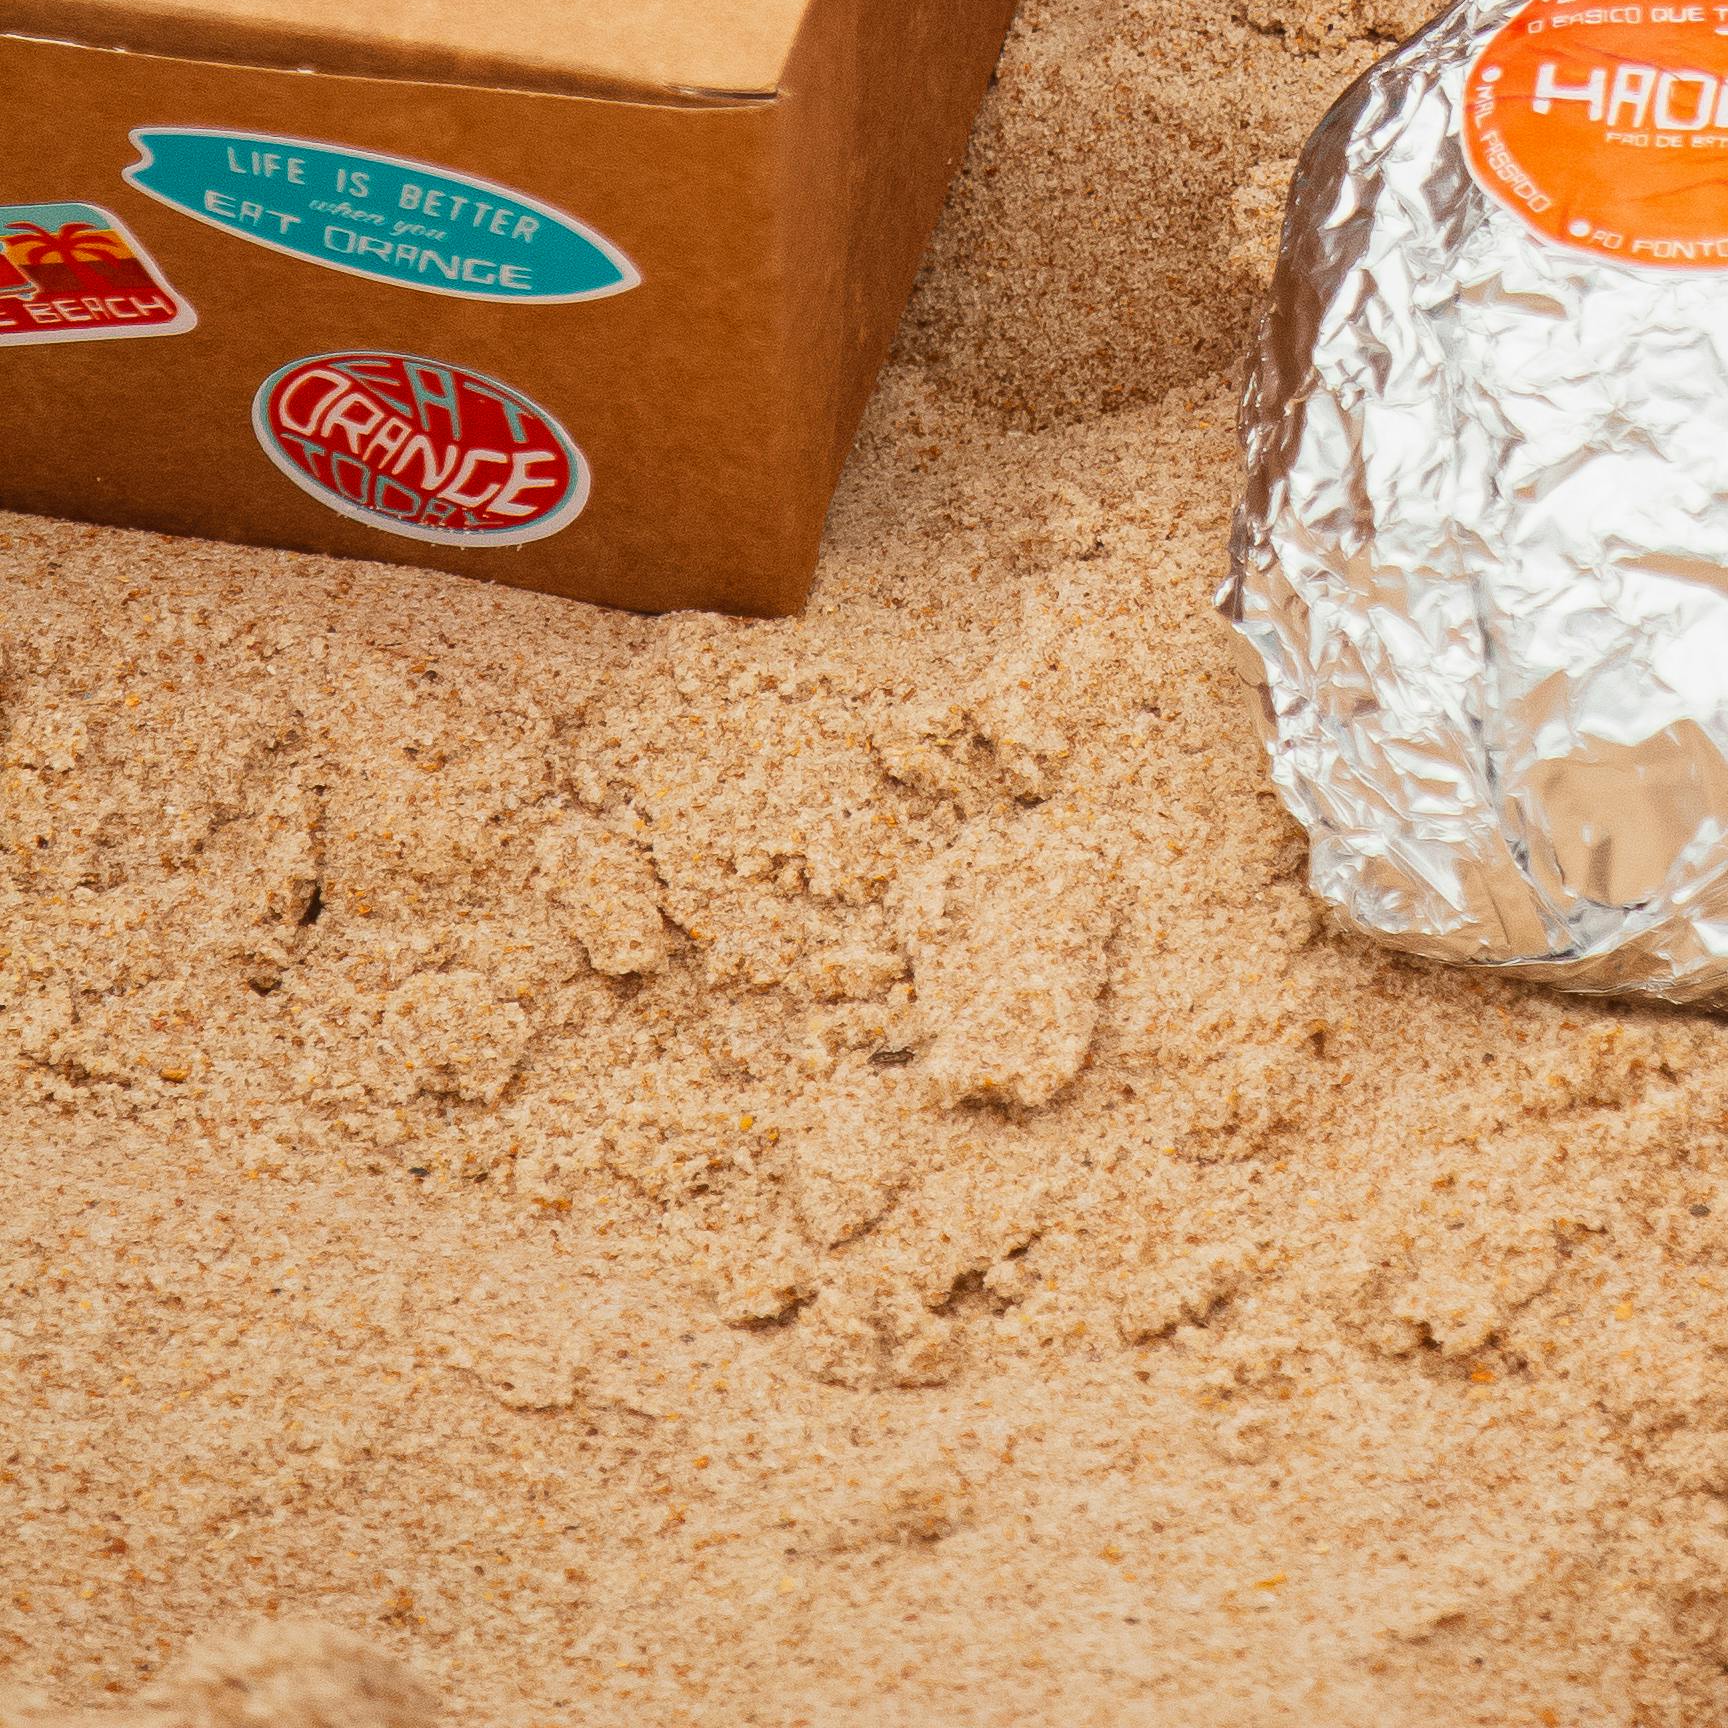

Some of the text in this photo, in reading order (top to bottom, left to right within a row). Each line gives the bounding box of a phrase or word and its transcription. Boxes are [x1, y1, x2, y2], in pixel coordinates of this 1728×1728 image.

[1650, 6, 1706, 23] QUE
[1473, 85, 1553, 215] MAL PASSADO
[1655, 133, 1684, 148] DE
[226, 146, 540, 244] LIFE IS BETTER
[308, 198, 449, 243] when you
[203, 189, 534, 291] EAT ORANGE
[23, 296, 174, 324] BEACH
[278, 369, 556, 517] ORANGE
